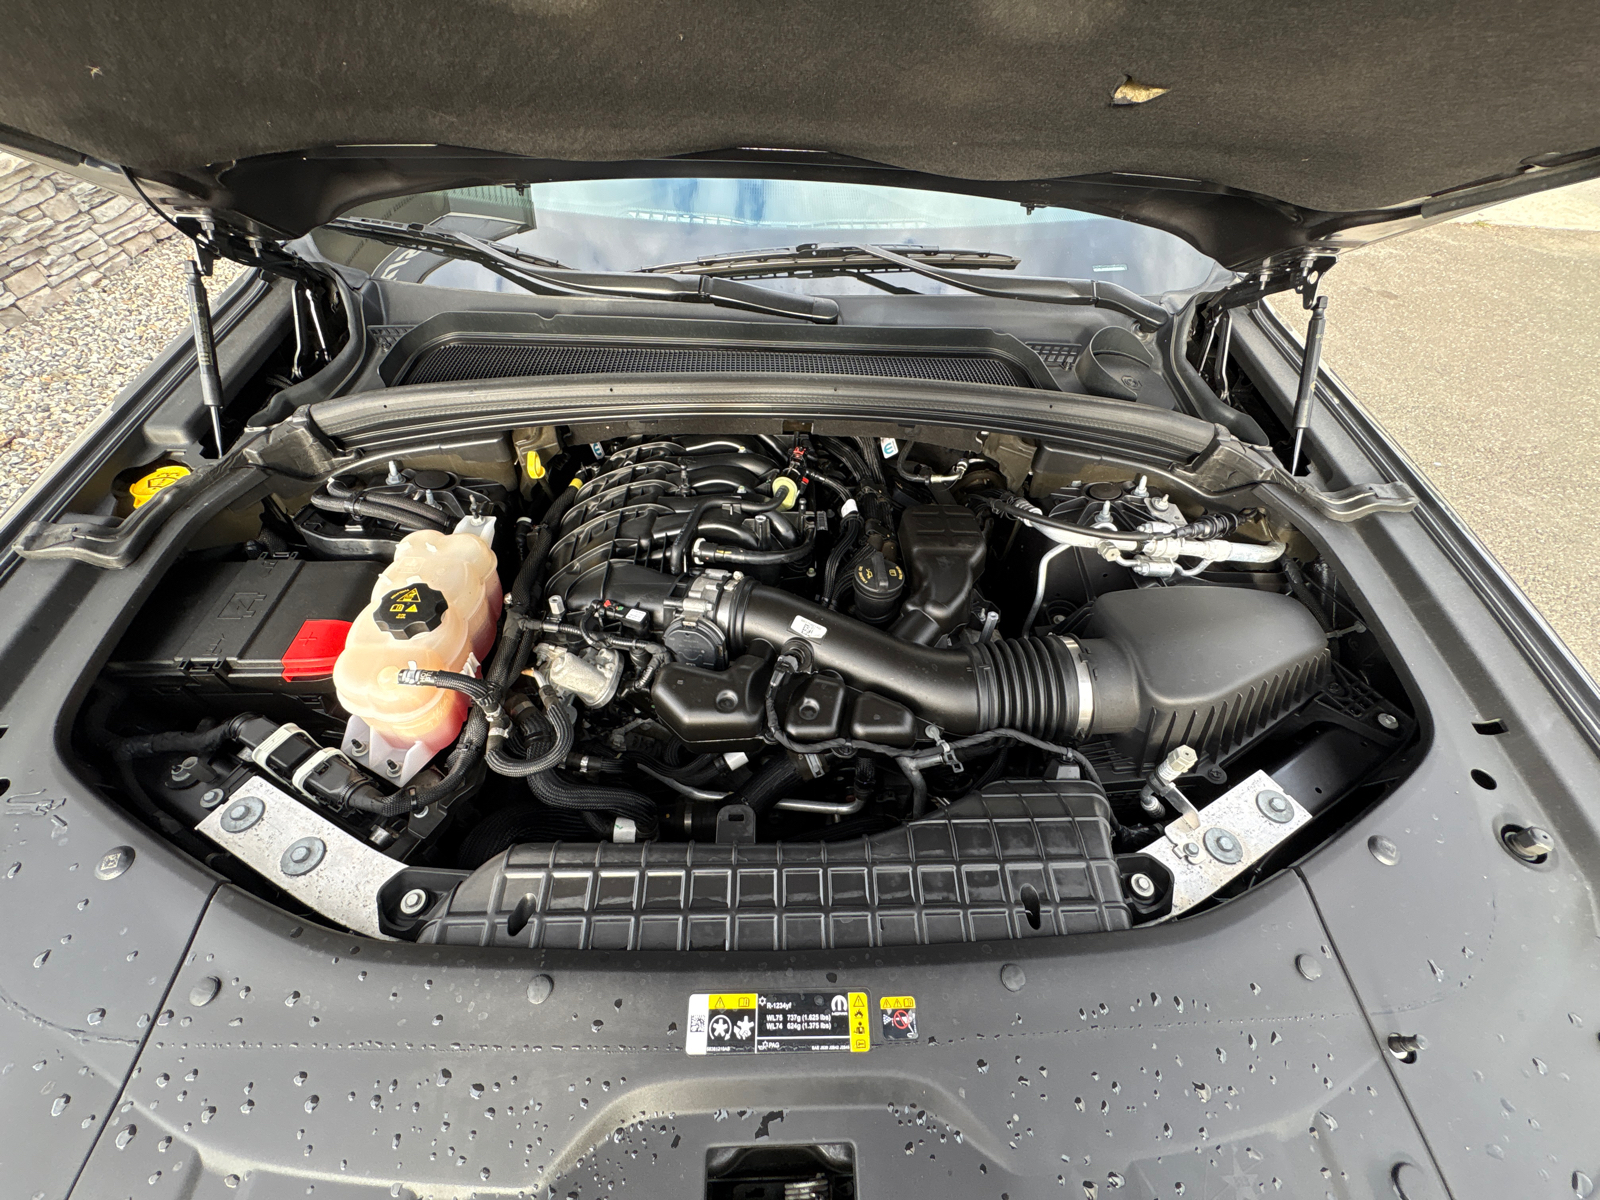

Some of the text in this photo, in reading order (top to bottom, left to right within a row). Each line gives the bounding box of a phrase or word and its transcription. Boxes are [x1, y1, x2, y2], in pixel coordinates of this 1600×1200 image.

[766, 1002, 792, 1010] R-1234yf
[786, 1014, 801, 1022] 737g
[820, 1013, 831, 1021] lbs)
[766, 1022, 831, 1031] WL74 624g (1.375 lbs)
